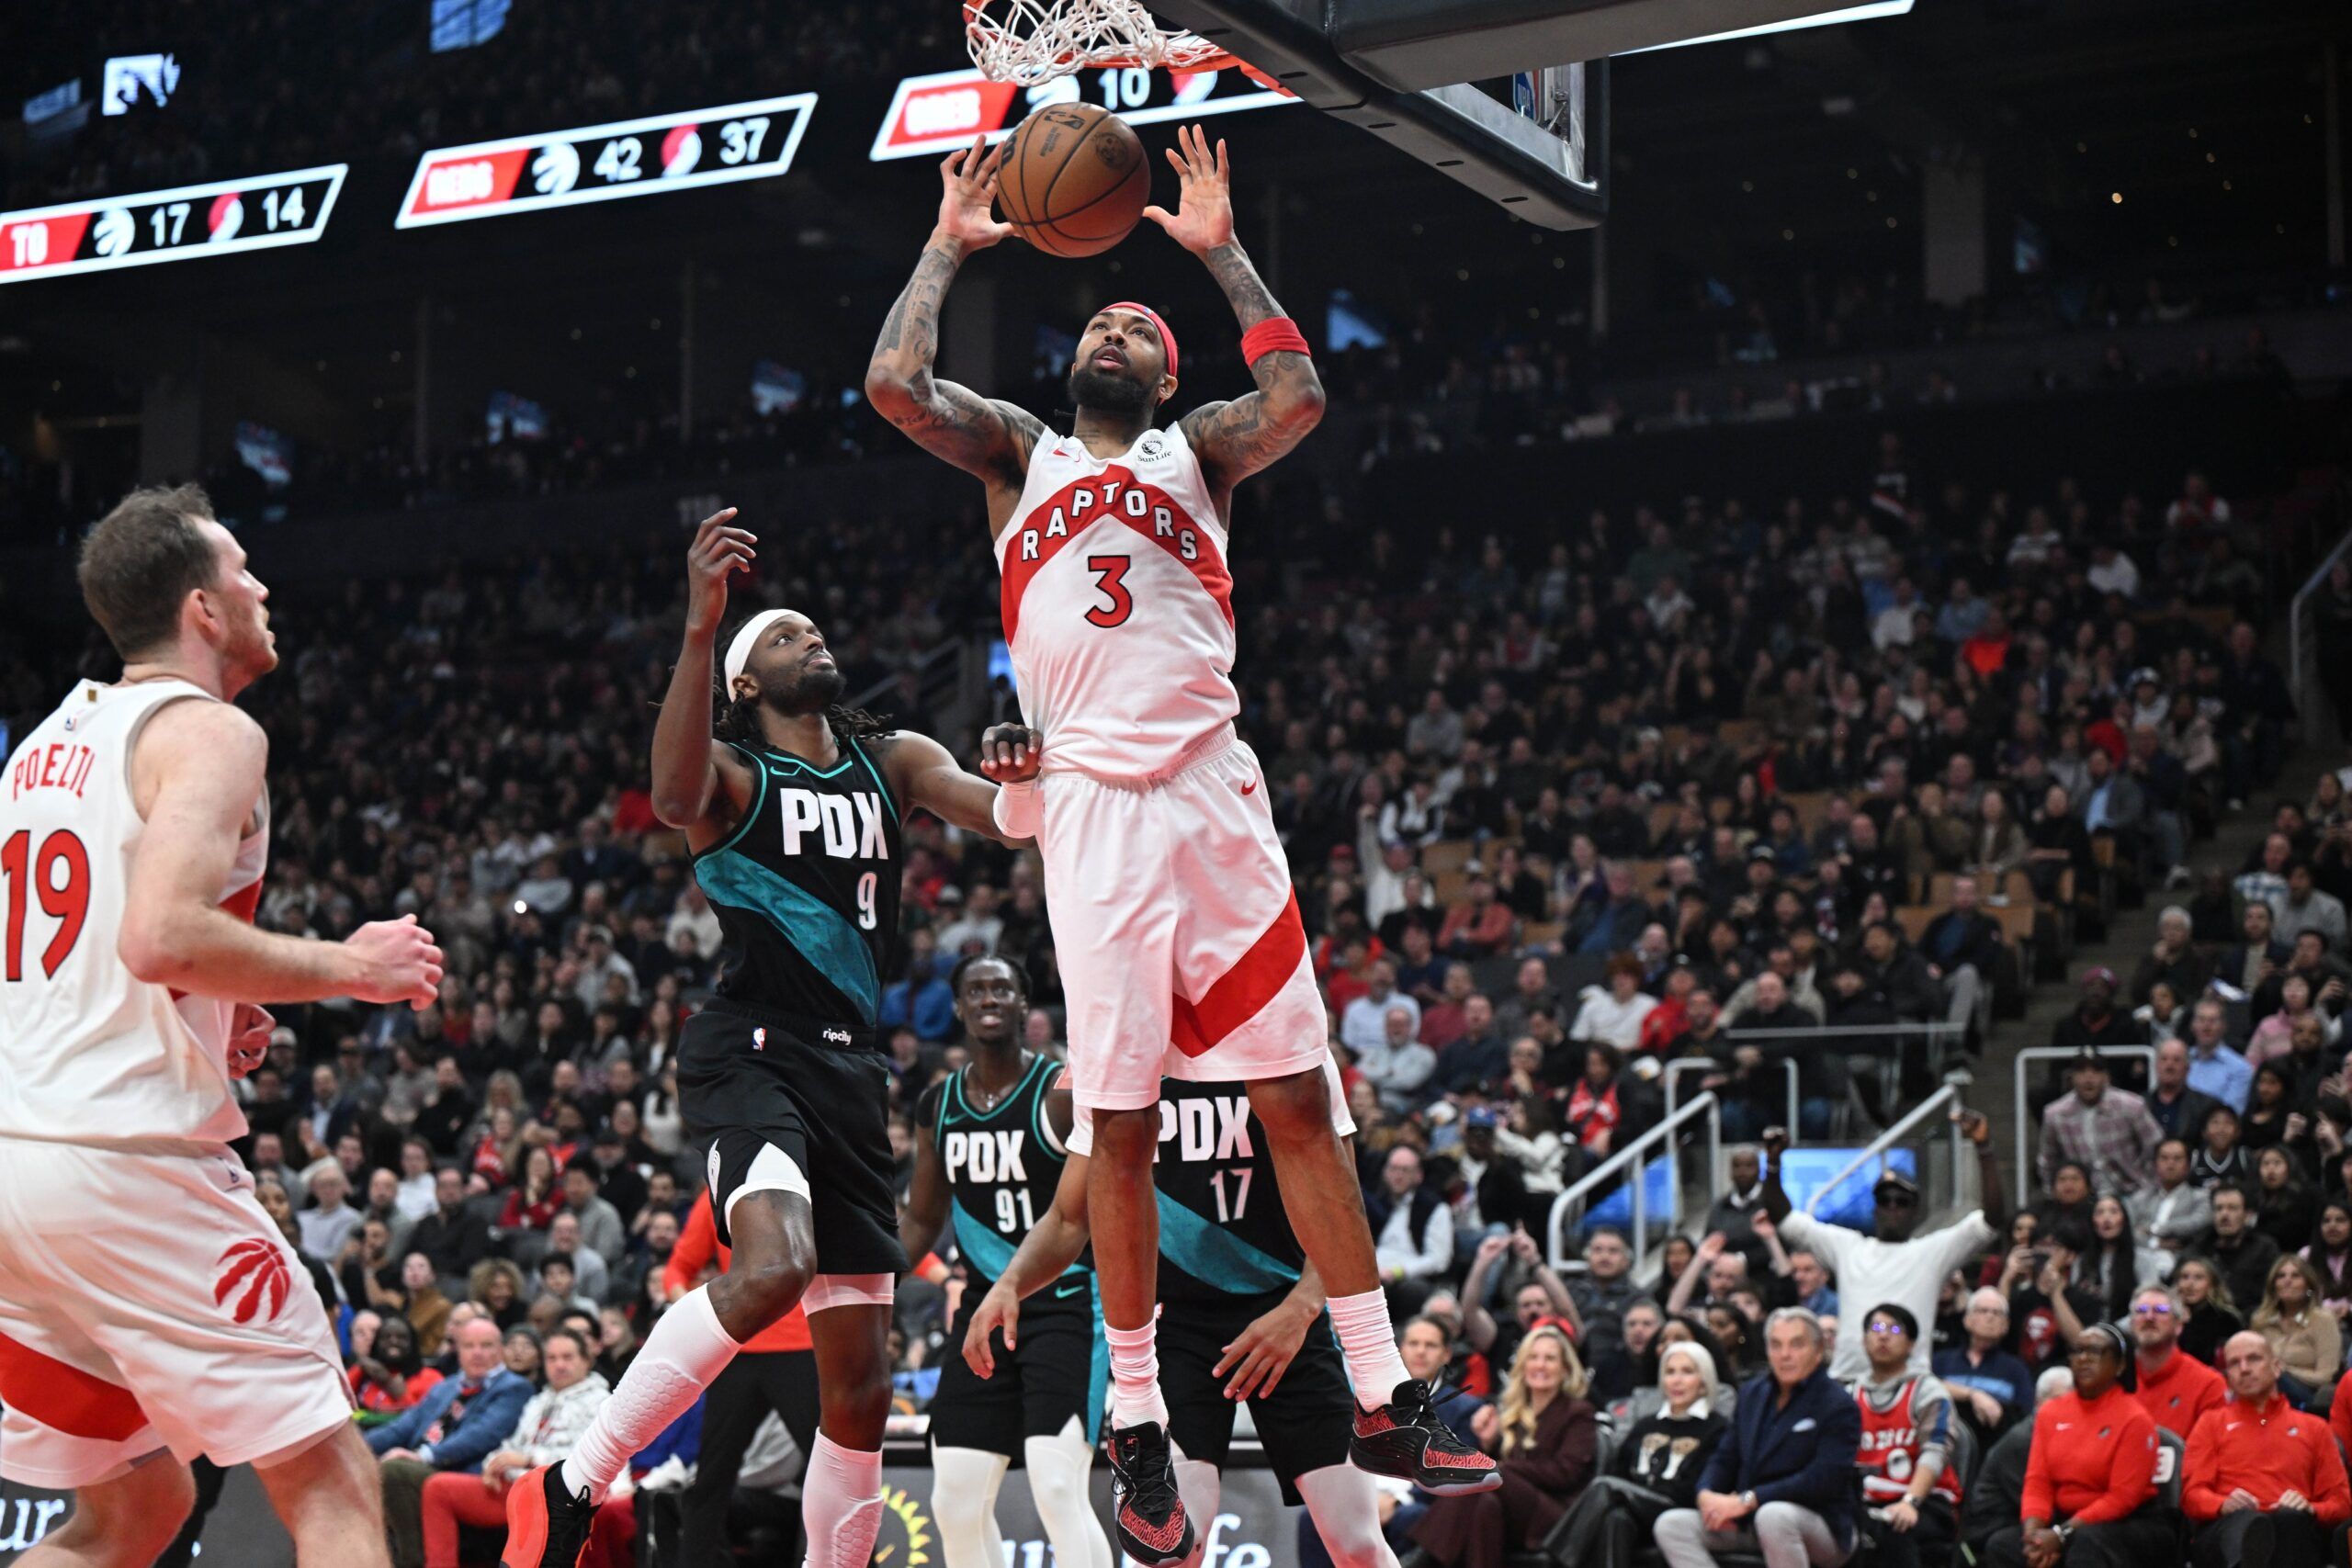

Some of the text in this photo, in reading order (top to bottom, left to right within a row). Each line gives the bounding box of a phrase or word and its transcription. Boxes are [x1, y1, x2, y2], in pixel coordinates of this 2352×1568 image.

[1098, 68, 1150, 110] 10
[594, 138, 642, 182] 42
[720, 118, 770, 164] 37
[151, 203, 190, 247] 17
[263, 186, 305, 231] 14
[1021, 482, 1198, 562] RAPTORS
[1084, 555, 1133, 628] 3
[780, 788, 888, 860] PDX
[1, 829, 91, 981] 19
[857, 872, 877, 930] 9
[944, 1129, 1027, 1184] PDX
[1153, 1096, 1255, 1163] PDX
[995, 1188, 1034, 1234] 91
[1210, 1168, 1253, 1224] 17
